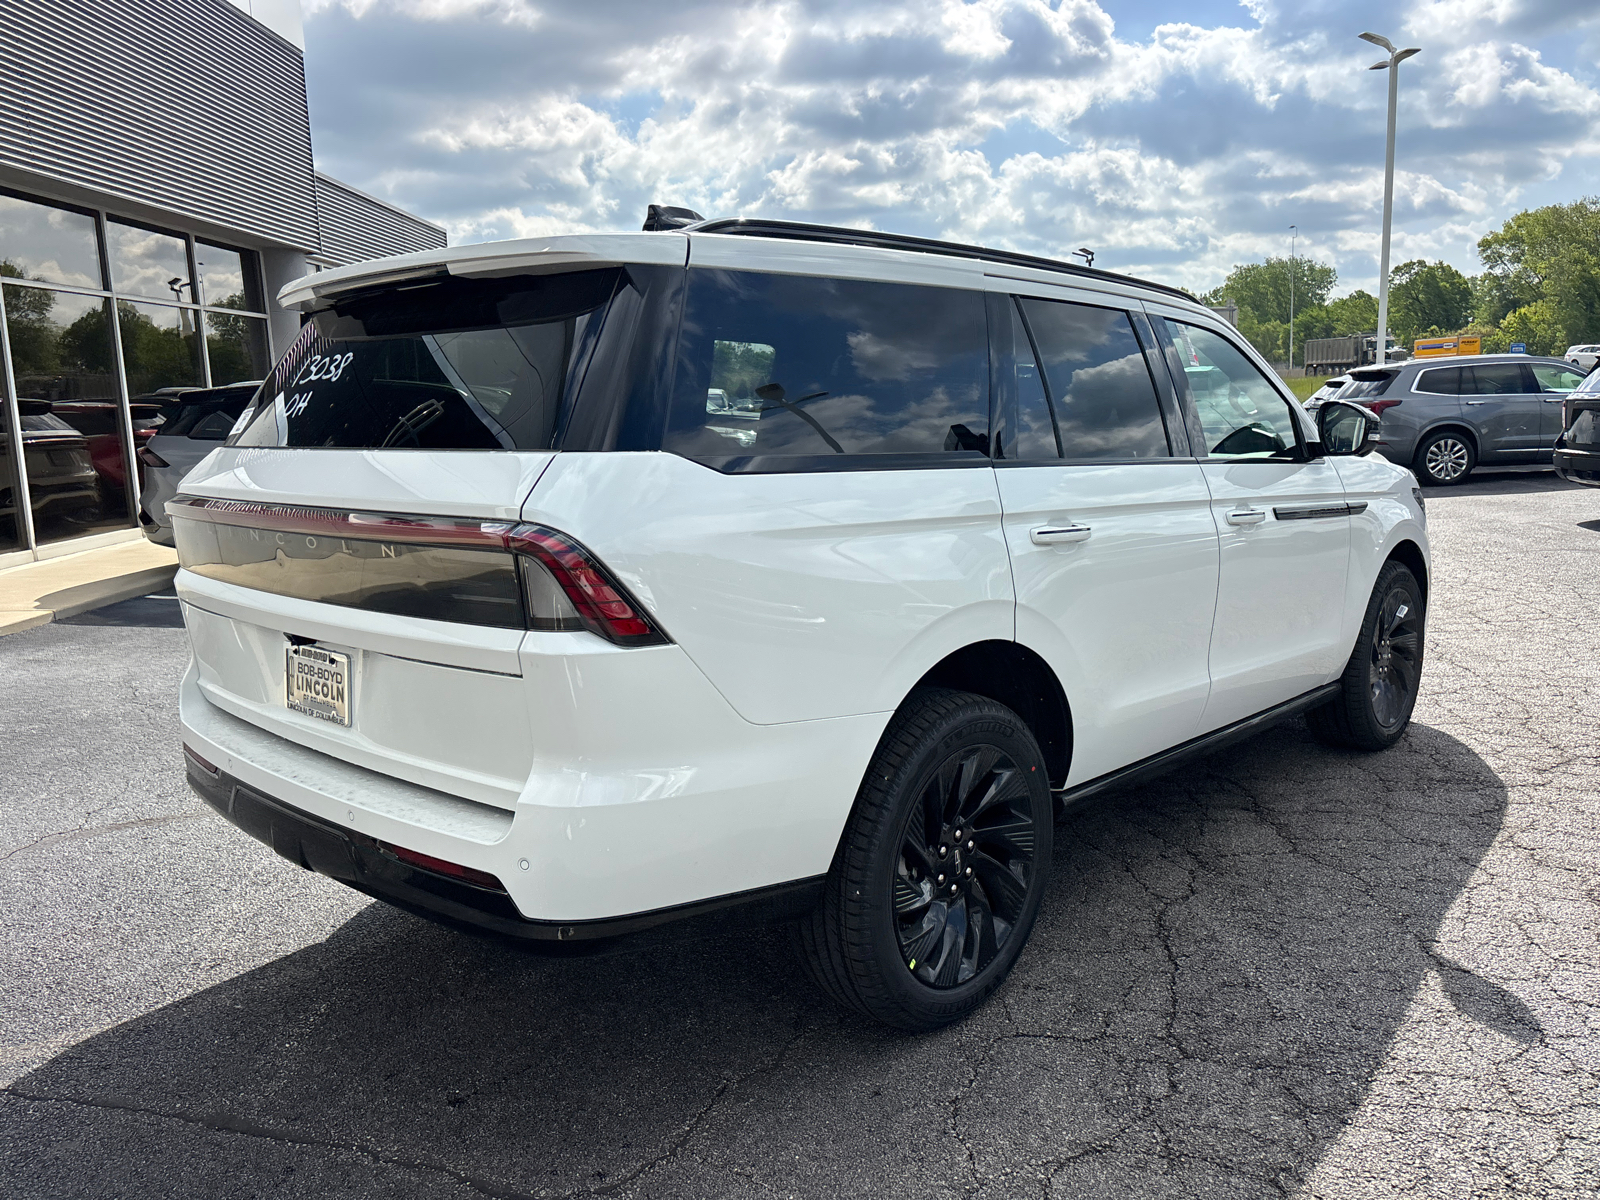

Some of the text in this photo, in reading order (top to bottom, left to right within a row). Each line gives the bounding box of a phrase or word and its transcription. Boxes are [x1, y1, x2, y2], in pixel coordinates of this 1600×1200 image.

[207, 523, 395, 558] LINCOLN
[298, 662, 342, 684] BOB-BOYD
[296, 674, 344, 703] LINCOLN
[287, 702, 307, 715] LINCOLN
